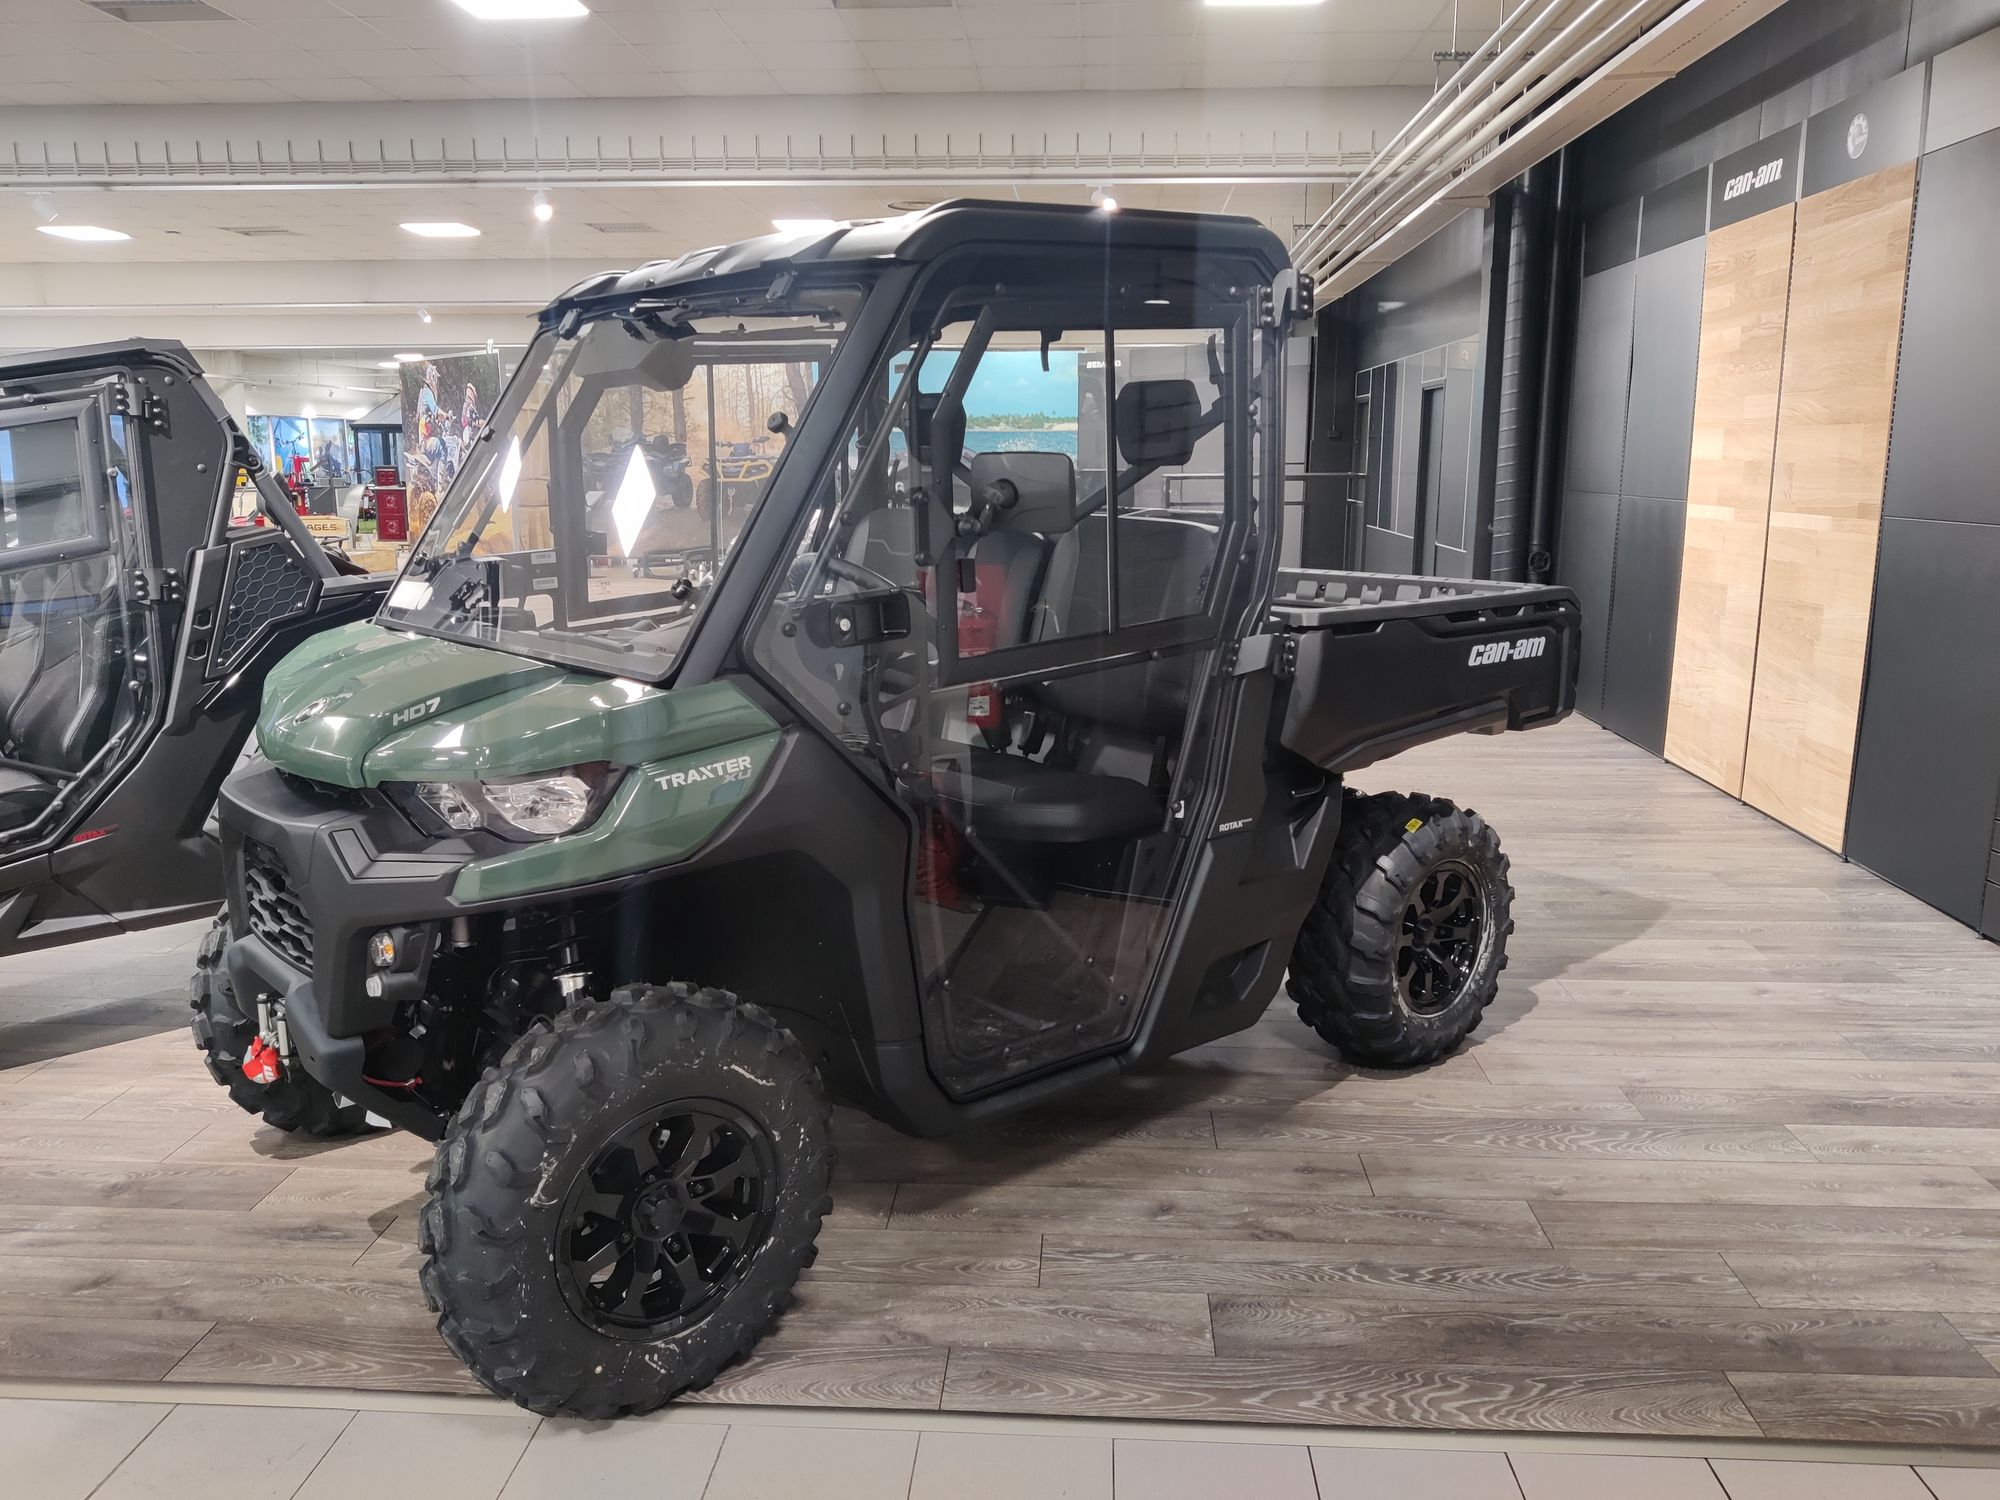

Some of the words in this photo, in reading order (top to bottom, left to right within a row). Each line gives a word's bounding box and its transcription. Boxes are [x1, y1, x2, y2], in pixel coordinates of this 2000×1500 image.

[1723, 158, 1784, 201] can-am
[1468, 636, 1546, 667] can-am
[392, 696, 441, 727] HD7
[654, 755, 753, 791] TRAXTER
[1218, 819, 1244, 833] ROTAX
